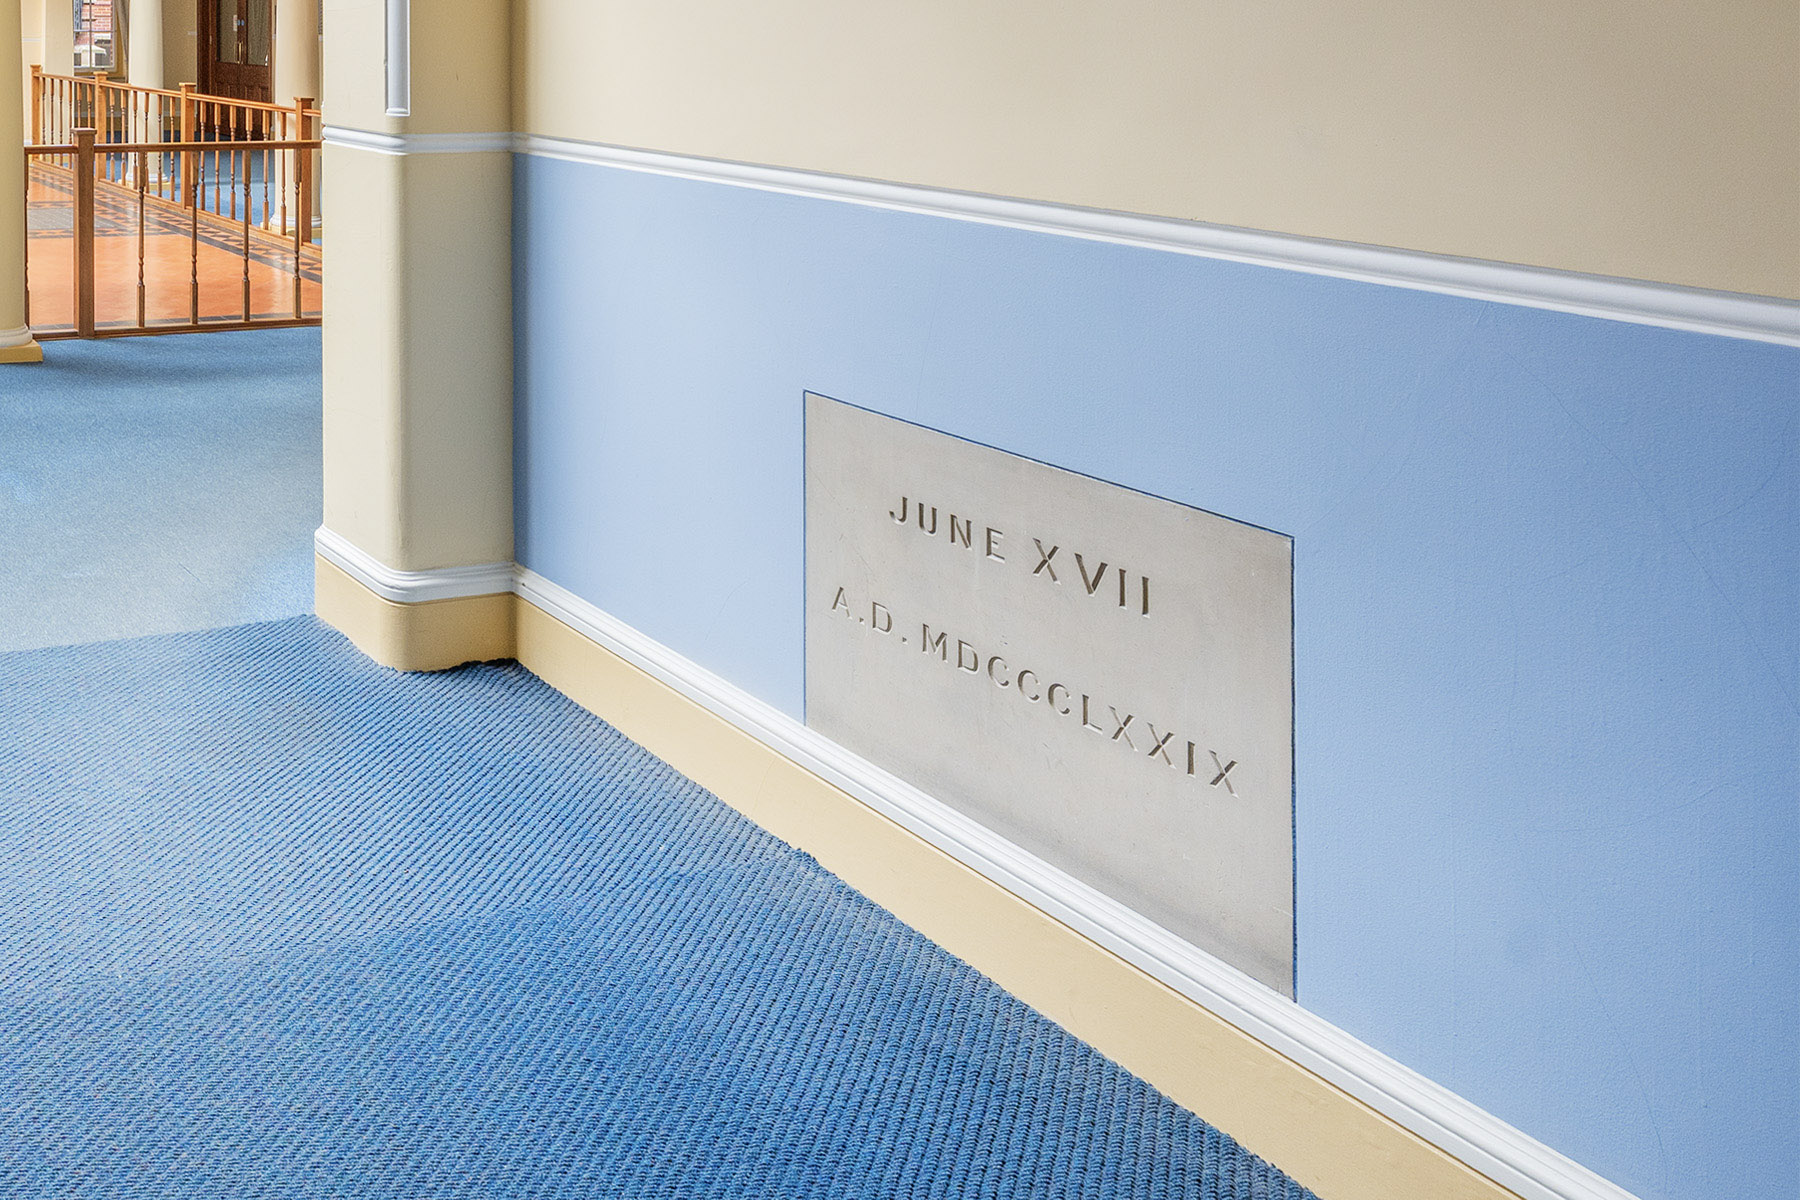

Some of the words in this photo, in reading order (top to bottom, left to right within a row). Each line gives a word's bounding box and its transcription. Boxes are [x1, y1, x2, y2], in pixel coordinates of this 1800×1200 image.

[890, 497, 1006, 563] JUNE
[1032, 538, 1151, 617] XVII
[831, 586, 908, 645] A.D.
[922, 623, 1238, 798] MDCCCLXXIX
